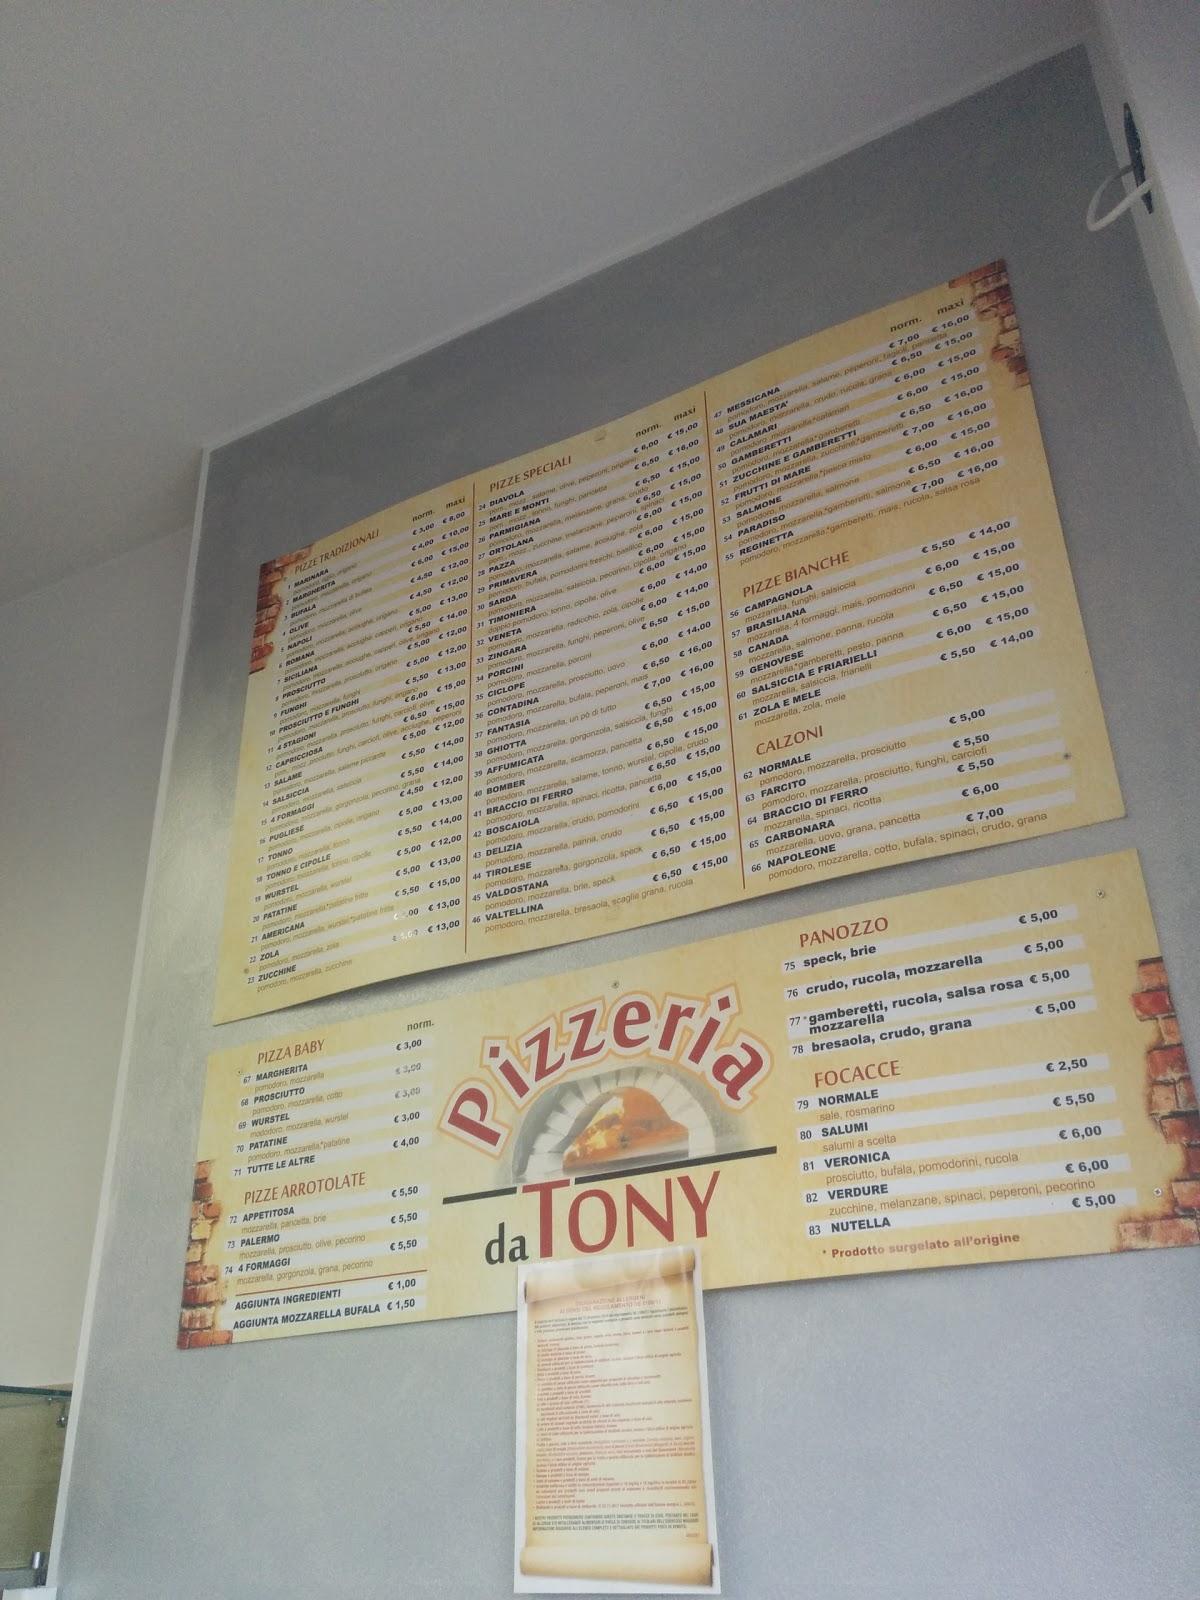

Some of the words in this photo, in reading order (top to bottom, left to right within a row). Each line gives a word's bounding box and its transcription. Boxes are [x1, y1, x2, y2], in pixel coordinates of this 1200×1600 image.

[937, 300, 964, 315] maxi
[890, 317, 922, 332] norm.
[727, 387, 780, 413] MESSICANA
[730, 424, 777, 447] CALAMARI
[733, 461, 781, 482] ZUCCHINE
[792, 430, 856, 456] GAMBERETTI
[490, 475, 521, 492] PIZZE
[523, 456, 571, 480] SPECIALI
[736, 496, 782, 519] SALMONE
[489, 518, 541, 539] PARMIGIANA
[738, 514, 786, 536] PARADISO
[320, 529, 379, 563] TRADIZIONALI
[740, 530, 794, 556] REGINETTA
[489, 560, 515, 573] PAZZA
[742, 575, 782, 597] PIZZE
[784, 551, 849, 582] BIANCHE
[489, 570, 537, 590] PRIMAVERA
[292, 580, 335, 603] MARGHERITA
[744, 584, 813, 613] CAMPAGNOLA
[488, 605, 536, 624] TIMONIERA
[746, 608, 807, 633] BRASILIANA
[488, 628, 522, 642] VENETA
[748, 635, 789, 654] CANADA
[488, 644, 526, 660] ZINGARA
[750, 651, 804, 674] GENOVESE
[751, 672, 806, 695] SALSICCIA
[808, 668, 815, 676] E
[818, 650, 877, 675] FRIARIELLI
[753, 702, 781, 717] ZOLA
[793, 689, 821, 705] MELE
[487, 719, 530, 735] FANTASIA
[756, 725, 824, 756] CALZONI
[487, 755, 544, 775] AFFUMICATA
[759, 753, 811, 775] NORMALE
[486, 780, 525, 794] BOMBER
[761, 778, 806, 797] FARCITO
[763, 801, 812, 821] BRACCIO
[815, 797, 827, 806] DI
[830, 786, 869, 802] FERRO
[269, 825, 304, 842] PUGLIESE
[486, 817, 540, 835] BOSCAIOLA
[765, 820, 835, 844] CARBONARA
[268, 848, 293, 861] TONNO
[486, 843, 522, 856] DELIZIA
[767, 844, 836, 868] NAPOLEONE
[768, 862, 815, 881] pomodoro,
[818, 850, 871, 868] mozzarella,
[874, 841, 900, 856] cotto,
[903, 835, 938, 851] bufala,
[940, 826, 980, 842] spinaci,
[981, 819, 1014, 833] crudo,
[1017, 813, 1047, 828] grana
[486, 862, 531, 877] TIROLESE
[486, 880, 548, 899] VALDOSTANA
[263, 904, 297, 920] PATATINE
[485, 904, 543, 921] VALTELLINA
[261, 922, 304, 941] AMERICANA
[799, 916, 889, 948] PANOZZO
[260, 950, 279, 961] ZOLA
[785, 961, 796, 971] 75
[803, 950, 847, 968] speck,
[850, 944, 876, 958] brie
[258, 965, 296, 981] ZUCCHINE
[787, 988, 798, 998] 76
[806, 976, 848, 996] crudo,
[852, 967, 901, 987] rucola,
[904, 954, 983, 977] mozzarella
[789, 1016, 801, 1026] 77
[892, 991, 943, 1010] rucola,
[946, 985, 986, 999] salsa
[990, 978, 1024, 993] rosa
[407, 1021, 434, 1031] norm.
[809, 1013, 884, 1035] mozzarella
[792, 1045, 804, 1055] 78
[811, 1033, 876, 1053] bresaola,
[879, 1024, 926, 1042] crudo,
[929, 1017, 972, 1037] grana
[258, 1045, 291, 1064] PIZZA
[294, 1039, 325, 1056] BABY
[256, 1064, 308, 1082] MARGHERITA
[448, 995, 763, 1146] Pizzeria
[814, 1060, 901, 1088] FOCACCE
[254, 1087, 305, 1104] PROSCIUTTO
[797, 1100, 809, 1110] 79
[818, 1089, 879, 1107] NORMALE
[251, 1113, 290, 1127] WURSTEL
[820, 1110, 843, 1121] sale,
[845, 1102, 895, 1117] rosmarino
[800, 1130, 812, 1140] 80
[821, 1122, 868, 1137] SALUMI
[249, 1137, 287, 1151] PATATINE
[822, 1139, 854, 1153] salumi
[866, 1133, 896, 1145] scelta
[247, 1161, 273, 1174] TUTTE
[276, 1160, 286, 1170] LE
[288, 1155, 315, 1169] ALTRE
[803, 1161, 814, 1171] 81
[824, 1151, 890, 1169] VERONICA
[826, 1167, 878, 1185] prosciutto,
[881, 1162, 917, 1178] bufala,
[919, 1157, 982, 1174] pomodorini,
[985, 1152, 1018, 1165] rucola
[245, 1185, 278, 1205] PIZZE
[281, 1172, 366, 1199] ARROTOLATE
[806, 1193, 818, 1203] 82
[828, 1183, 888, 1201] VERDURE
[243, 1207, 294, 1222] APPETITOSA
[485, 1222, 529, 1265] da
[522, 1170, 720, 1259] TONY
[809, 1225, 821, 1235] 83
[831, 1217, 891, 1233] NUTELLA
[241, 1234, 279, 1247] PALERMO
[831, 1245, 884, 1258] Prodotto
[889, 1239, 950, 1254] surgelato
[953, 1233, 1020, 1247] all'origine
[238, 1264, 243, 1272] 4
[246, 1258, 290, 1271] FORMAGGI
[235, 1298, 280, 1310] AGGIUNTA
[283, 1290, 341, 1305] INGREDIENTI
[233, 1316, 279, 1330] AGGIUNTA
[282, 1308, 342, 1323] MOZZARELLA
[345, 1304, 380, 1316] BUFALA
